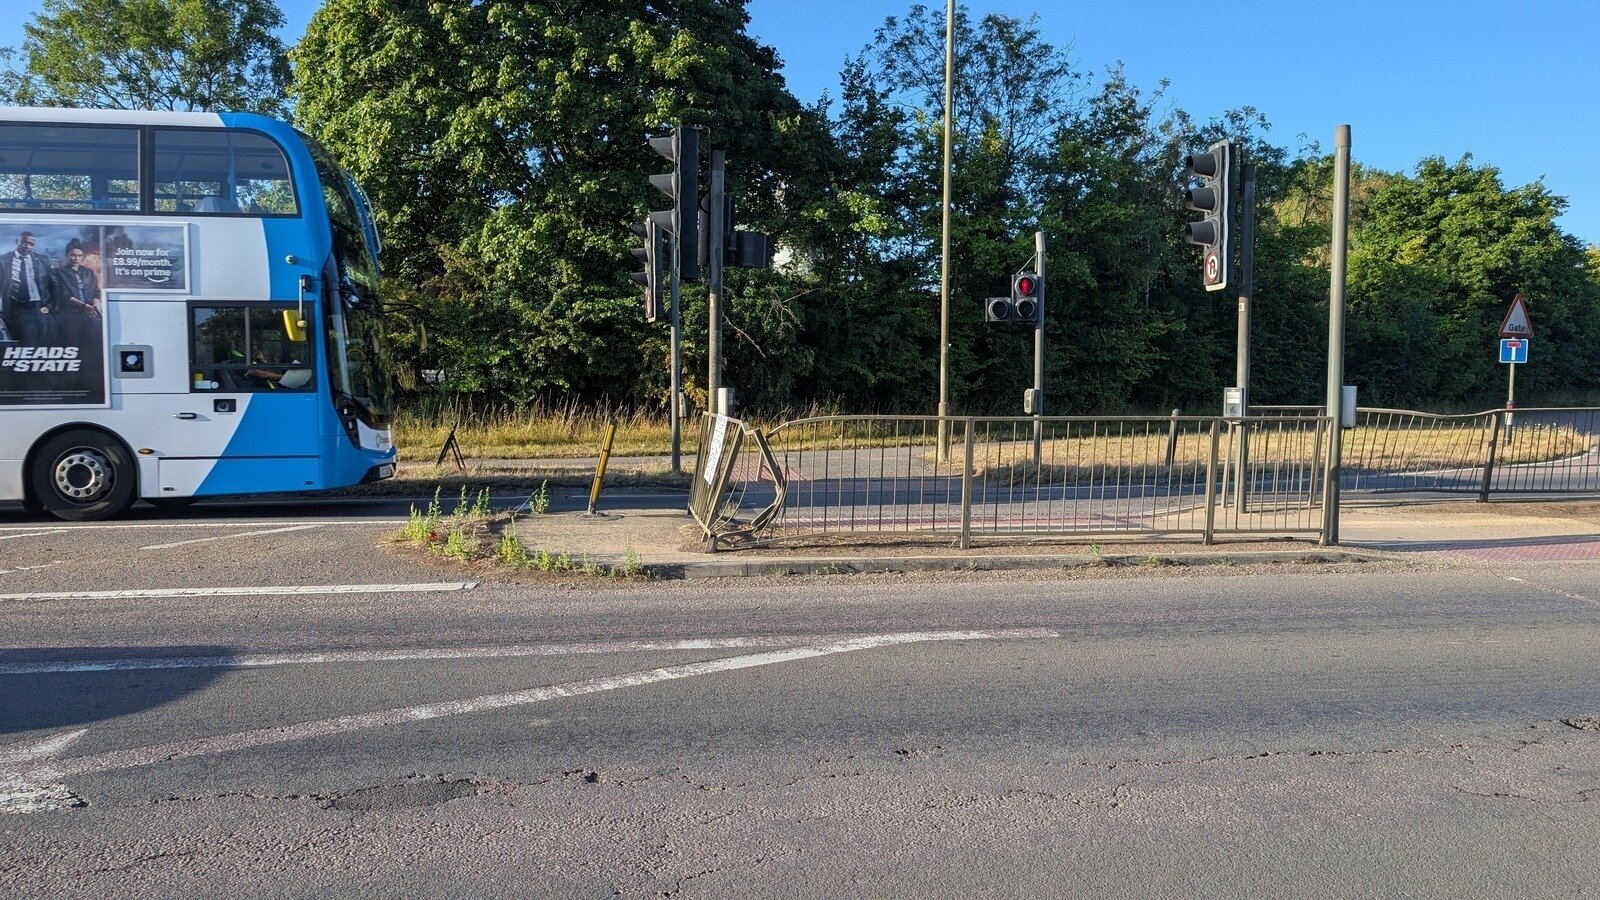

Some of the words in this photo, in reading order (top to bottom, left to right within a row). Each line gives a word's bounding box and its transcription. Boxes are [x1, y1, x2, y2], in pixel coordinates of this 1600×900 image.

[115, 247, 134, 256] Join
[155, 248, 170, 256] for
[113, 257, 173, 267] £8.99/month.
[144, 268, 171, 277] prime
[1508, 323, 1526, 332] Gate
[3, 346, 79, 359] HEADS
[13, 359, 82, 372] STATE
